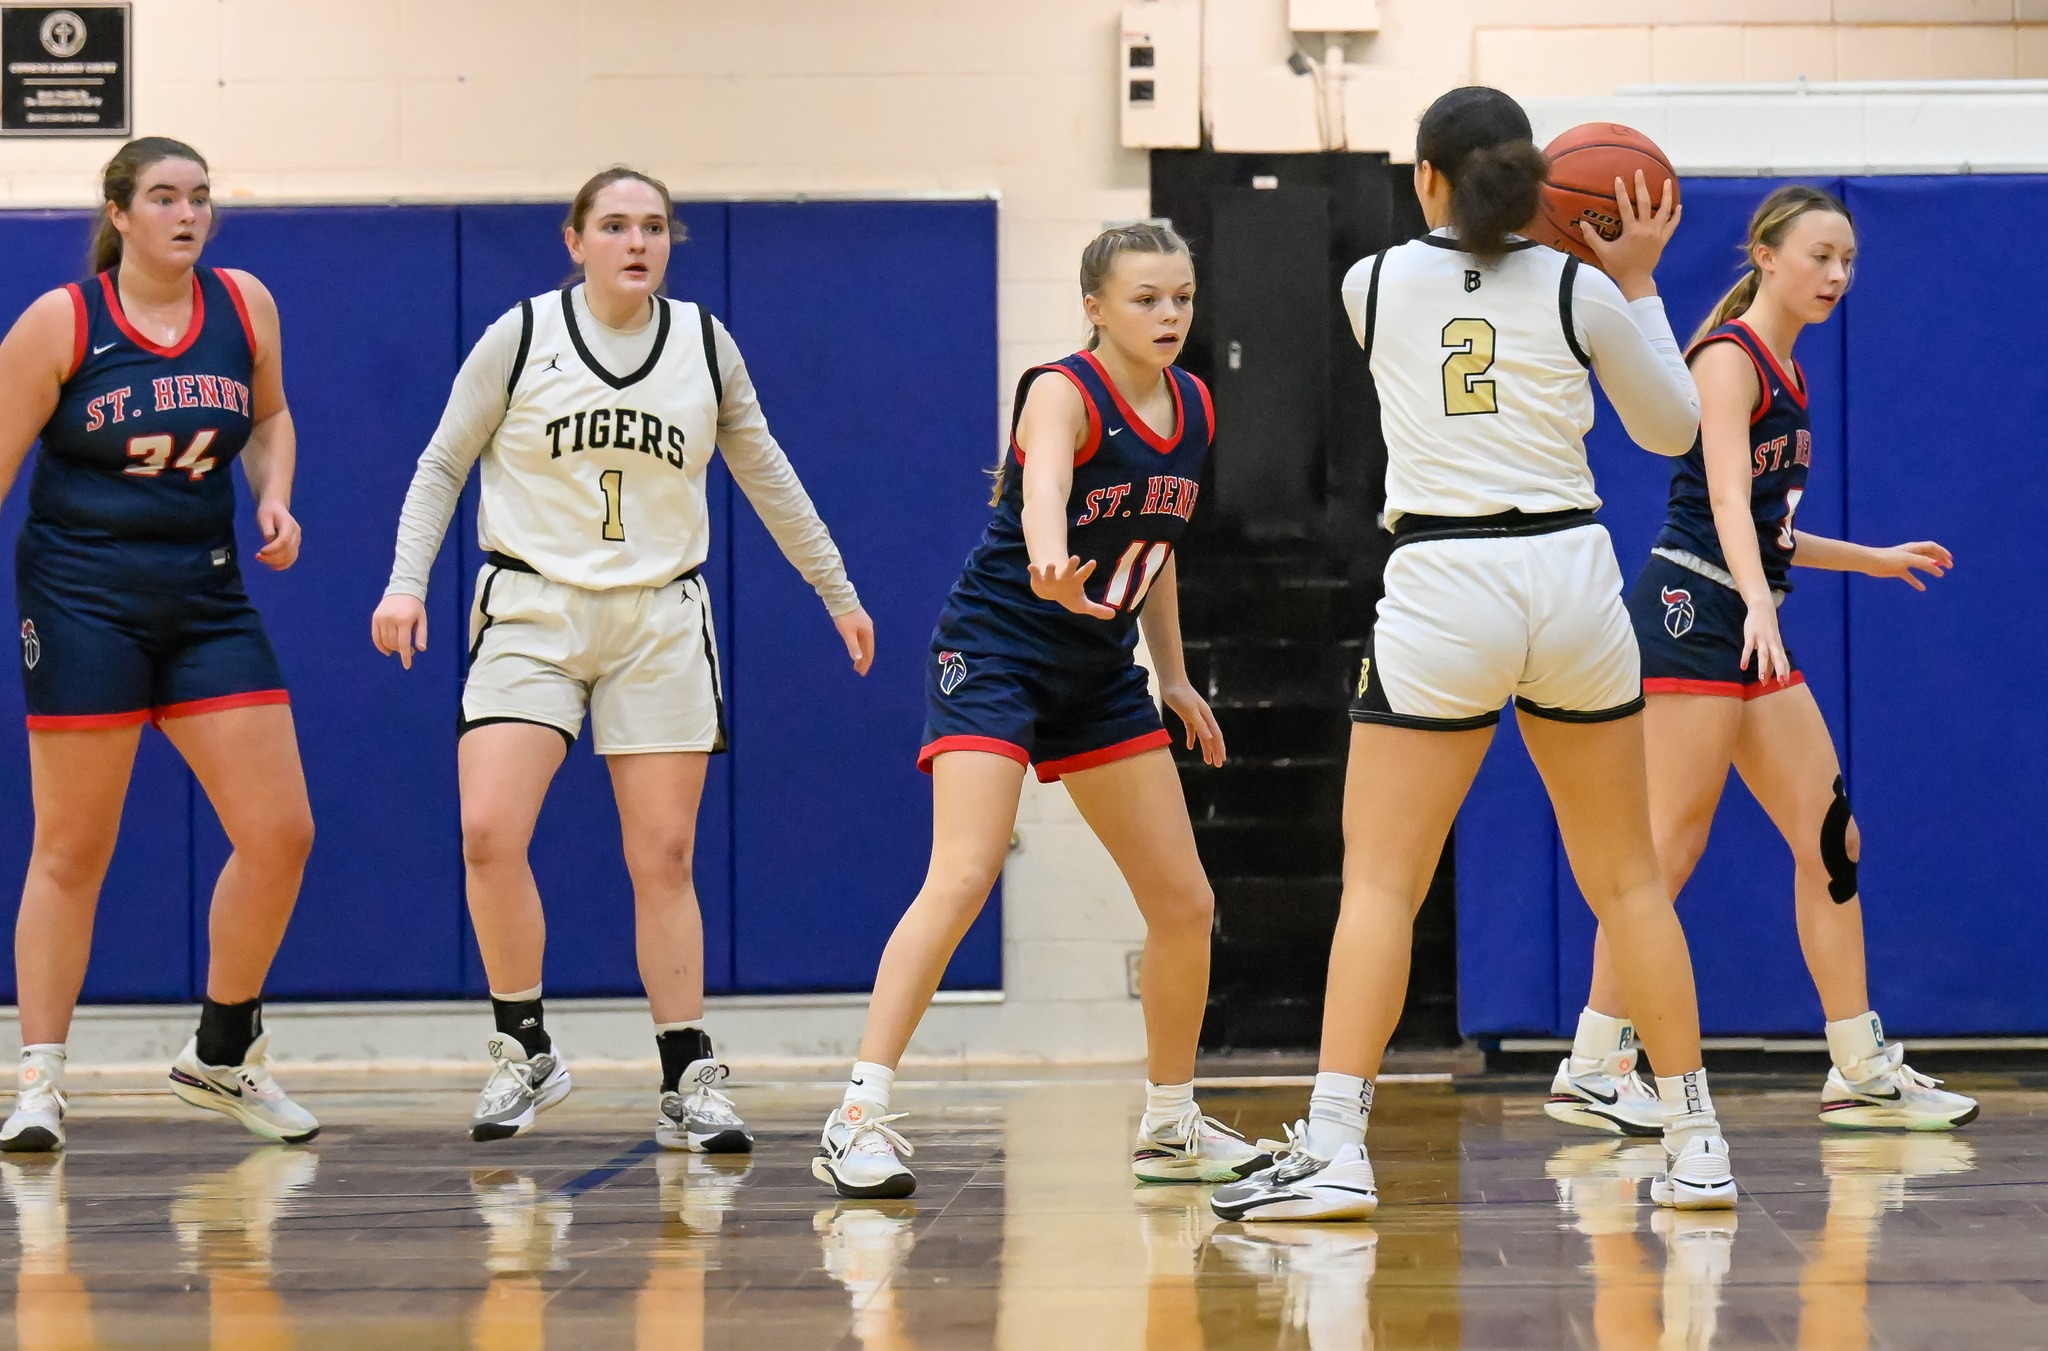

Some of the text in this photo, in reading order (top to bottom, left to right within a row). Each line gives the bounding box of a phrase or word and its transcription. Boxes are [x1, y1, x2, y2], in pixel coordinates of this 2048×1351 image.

[1464, 270, 1481, 293] B
[1441, 317, 1498, 416] 2
[86, 374, 249, 432] ST. HENRY
[121, 427, 219, 482] 34
[545, 408, 686, 470] TIGERS
[1751, 434, 1790, 478] ST.
[599, 469, 626, 542] 1
[1076, 483, 1131, 526] ST.
[1102, 539, 1170, 612] 11
